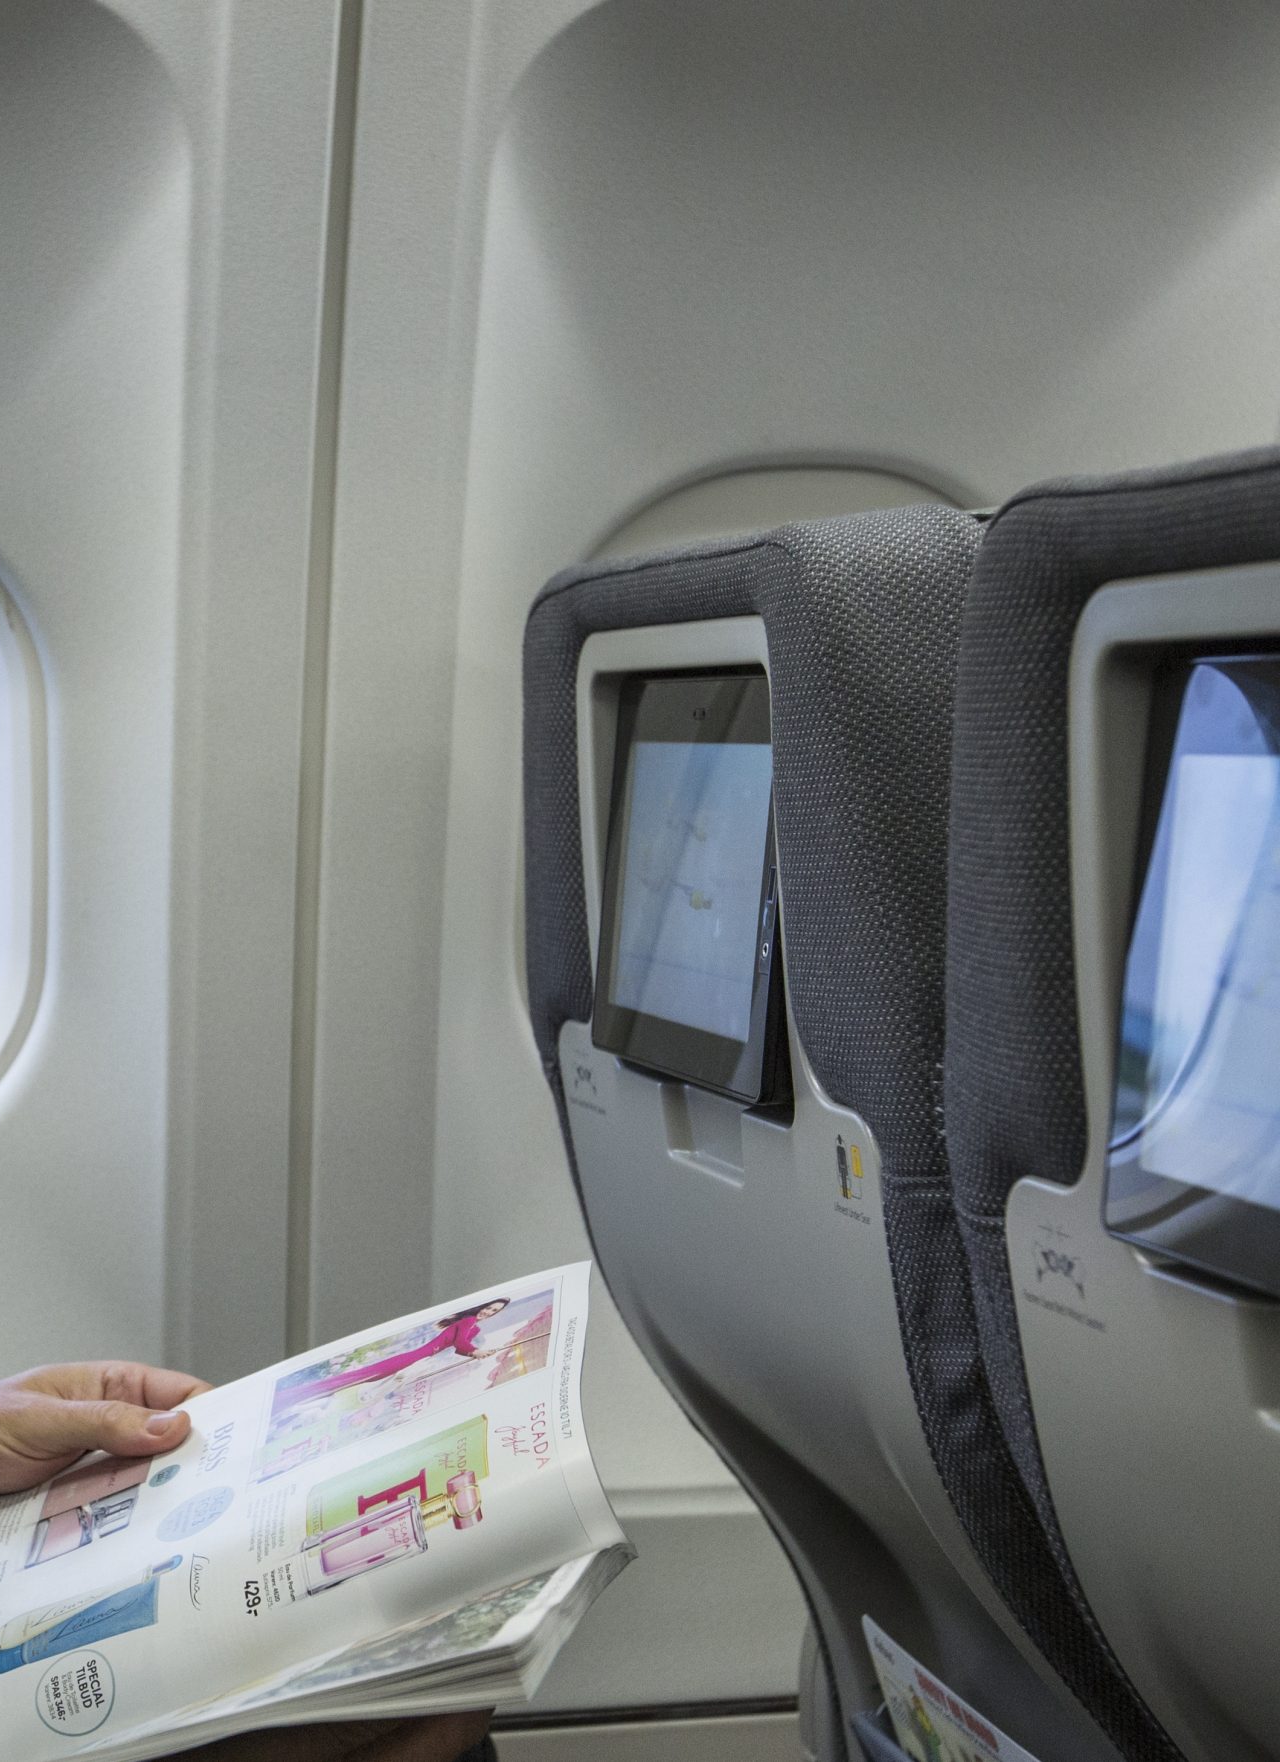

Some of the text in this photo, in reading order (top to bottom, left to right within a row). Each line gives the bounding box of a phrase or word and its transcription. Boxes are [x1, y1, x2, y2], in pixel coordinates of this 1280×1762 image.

[204, 1421, 235, 1472] BOSS
[530, 1402, 551, 1470] ESCADA
[189, 1552, 210, 1611] Laura
[244, 1580, 261, 1617] 429,-
[50, 1676, 61, 1700] SPAR
[76, 1666, 93, 1709] TILBUD
[86, 1659, 105, 1709] SPECIAL
